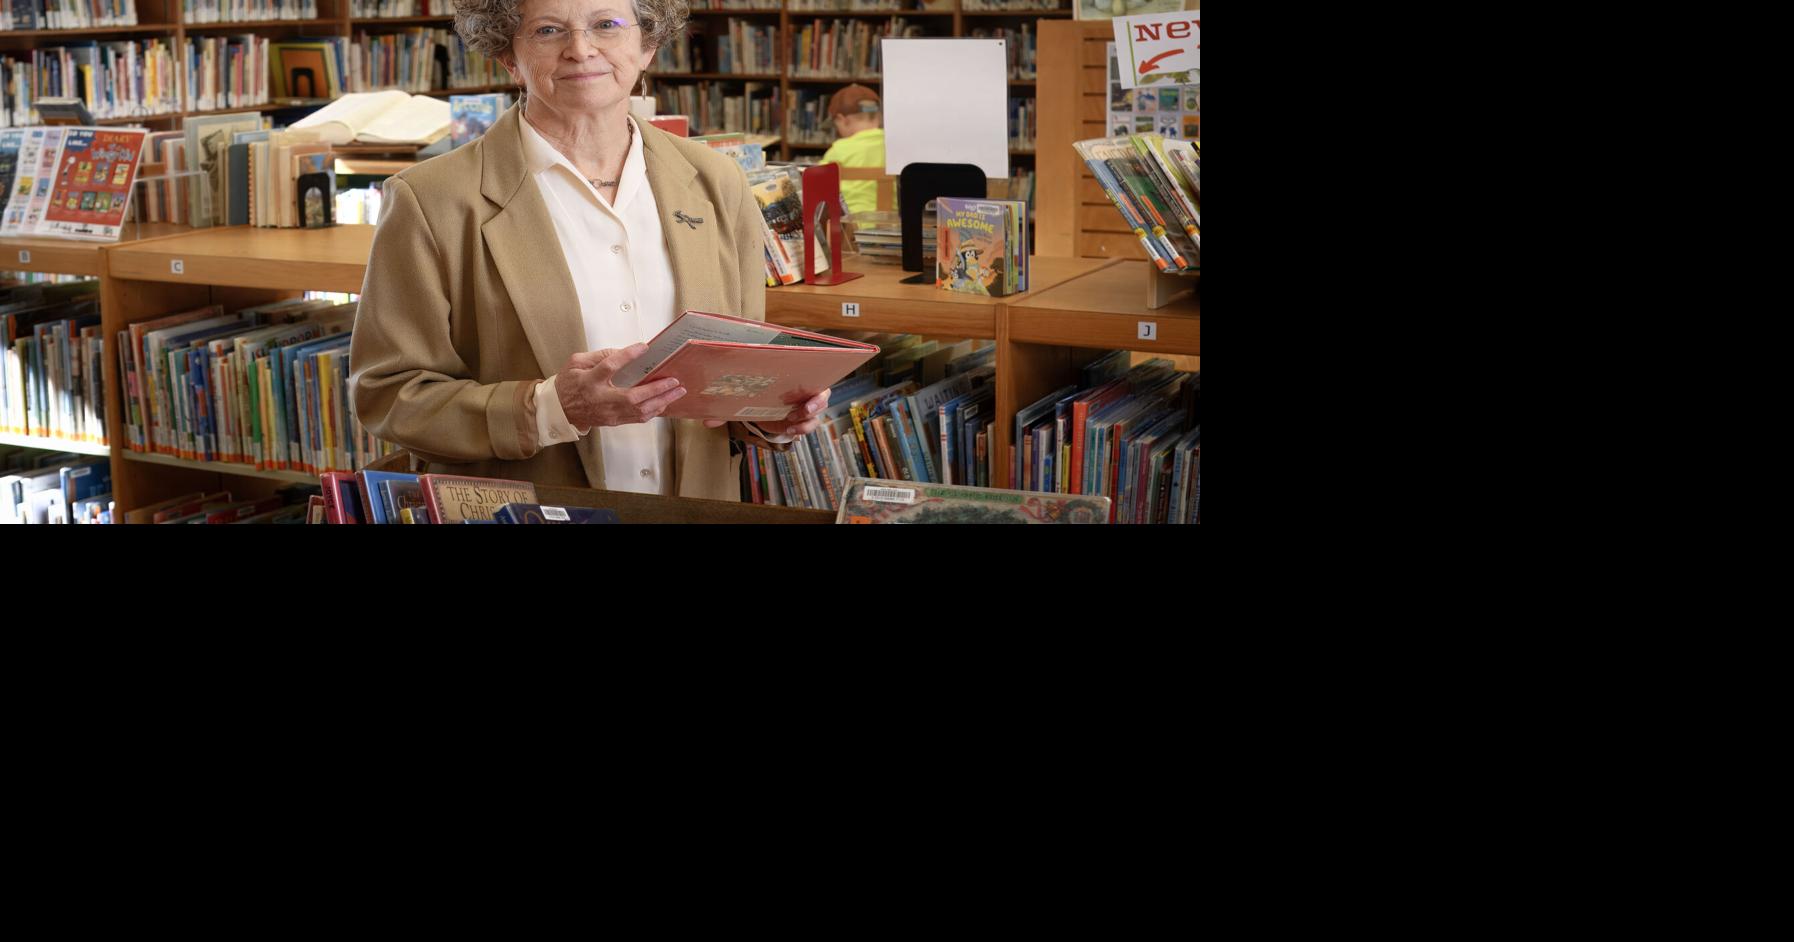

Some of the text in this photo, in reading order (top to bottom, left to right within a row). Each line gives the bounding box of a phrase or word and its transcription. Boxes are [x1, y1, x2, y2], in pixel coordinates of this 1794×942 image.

[947, 218, 994, 233] AWESOME
[174, 262, 182, 271] C
[846, 303, 856, 315] H
[1143, 325, 1151, 336] J
[446, 486, 472, 502] THE
[473, 485, 510, 504] STORY
[513, 491, 529, 504] OF
